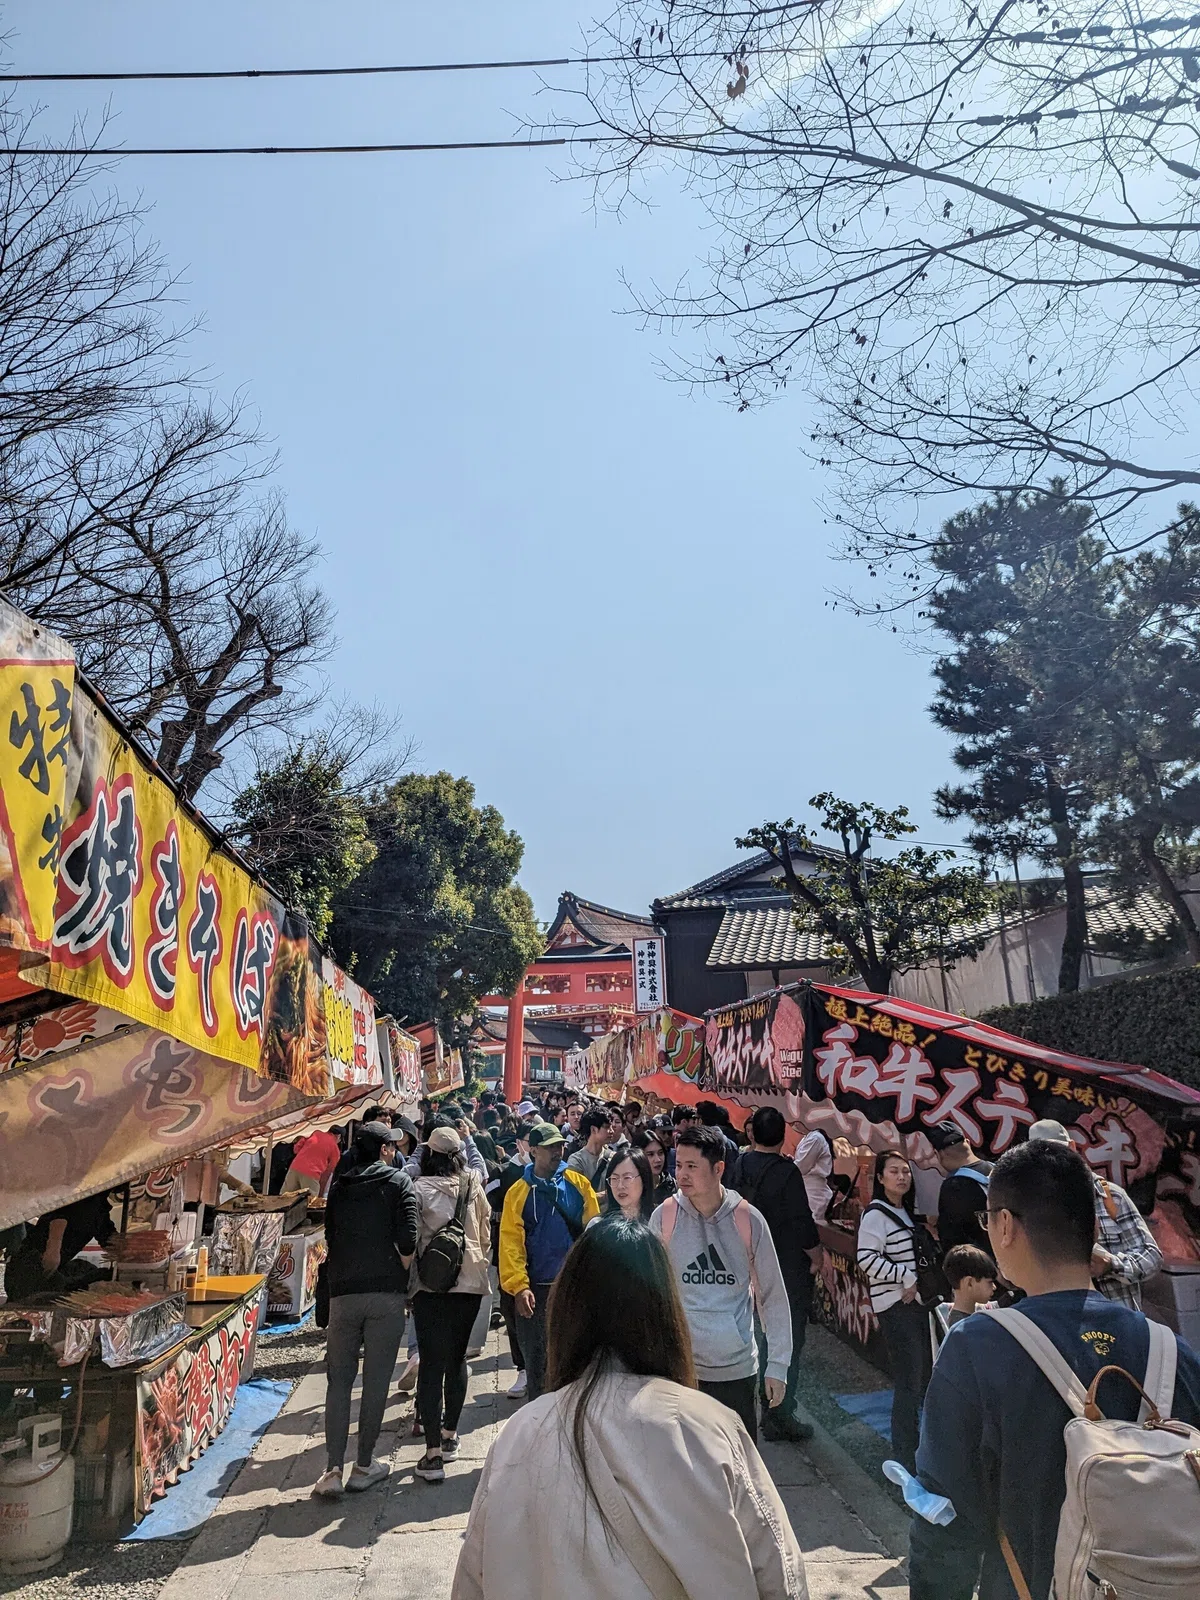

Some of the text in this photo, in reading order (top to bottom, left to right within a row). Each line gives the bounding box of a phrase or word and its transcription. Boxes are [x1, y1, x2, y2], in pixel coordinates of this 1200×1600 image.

[53, 772, 281, 1045] 焼きそば
[825, 995, 1137, 1118] 極上絶品！ とびきり美味い！
[681, 1270, 736, 1286] adidas
[1080, 1330, 1117, 1343] SNOOPY
